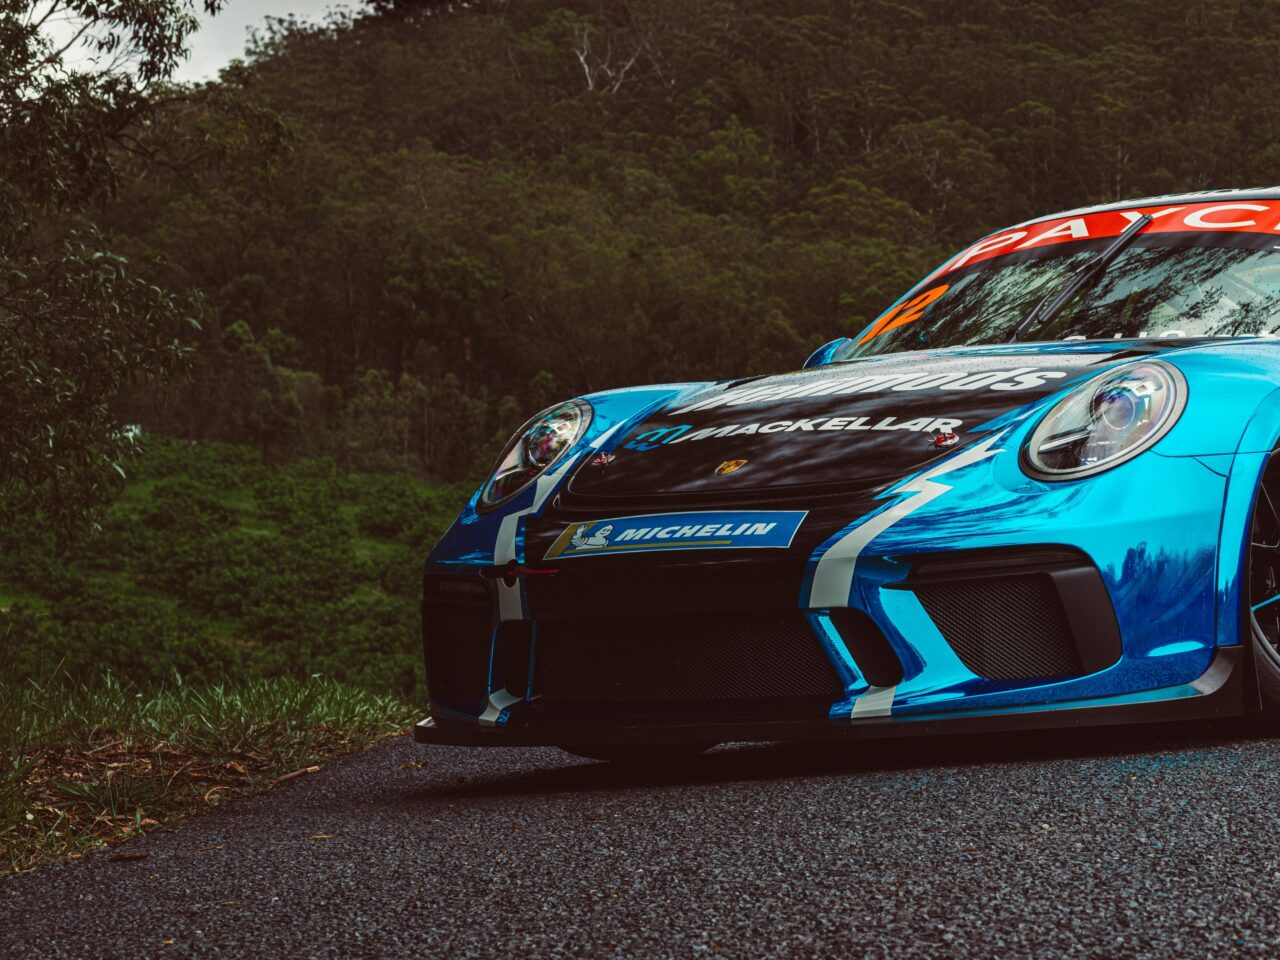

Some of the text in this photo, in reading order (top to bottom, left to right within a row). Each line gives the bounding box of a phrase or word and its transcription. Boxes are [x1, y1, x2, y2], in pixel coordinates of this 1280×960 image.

[856, 284, 950, 348] 12
[668, 416, 963, 445] MACKELLAR
[614, 522, 778, 542] MICHELIN
